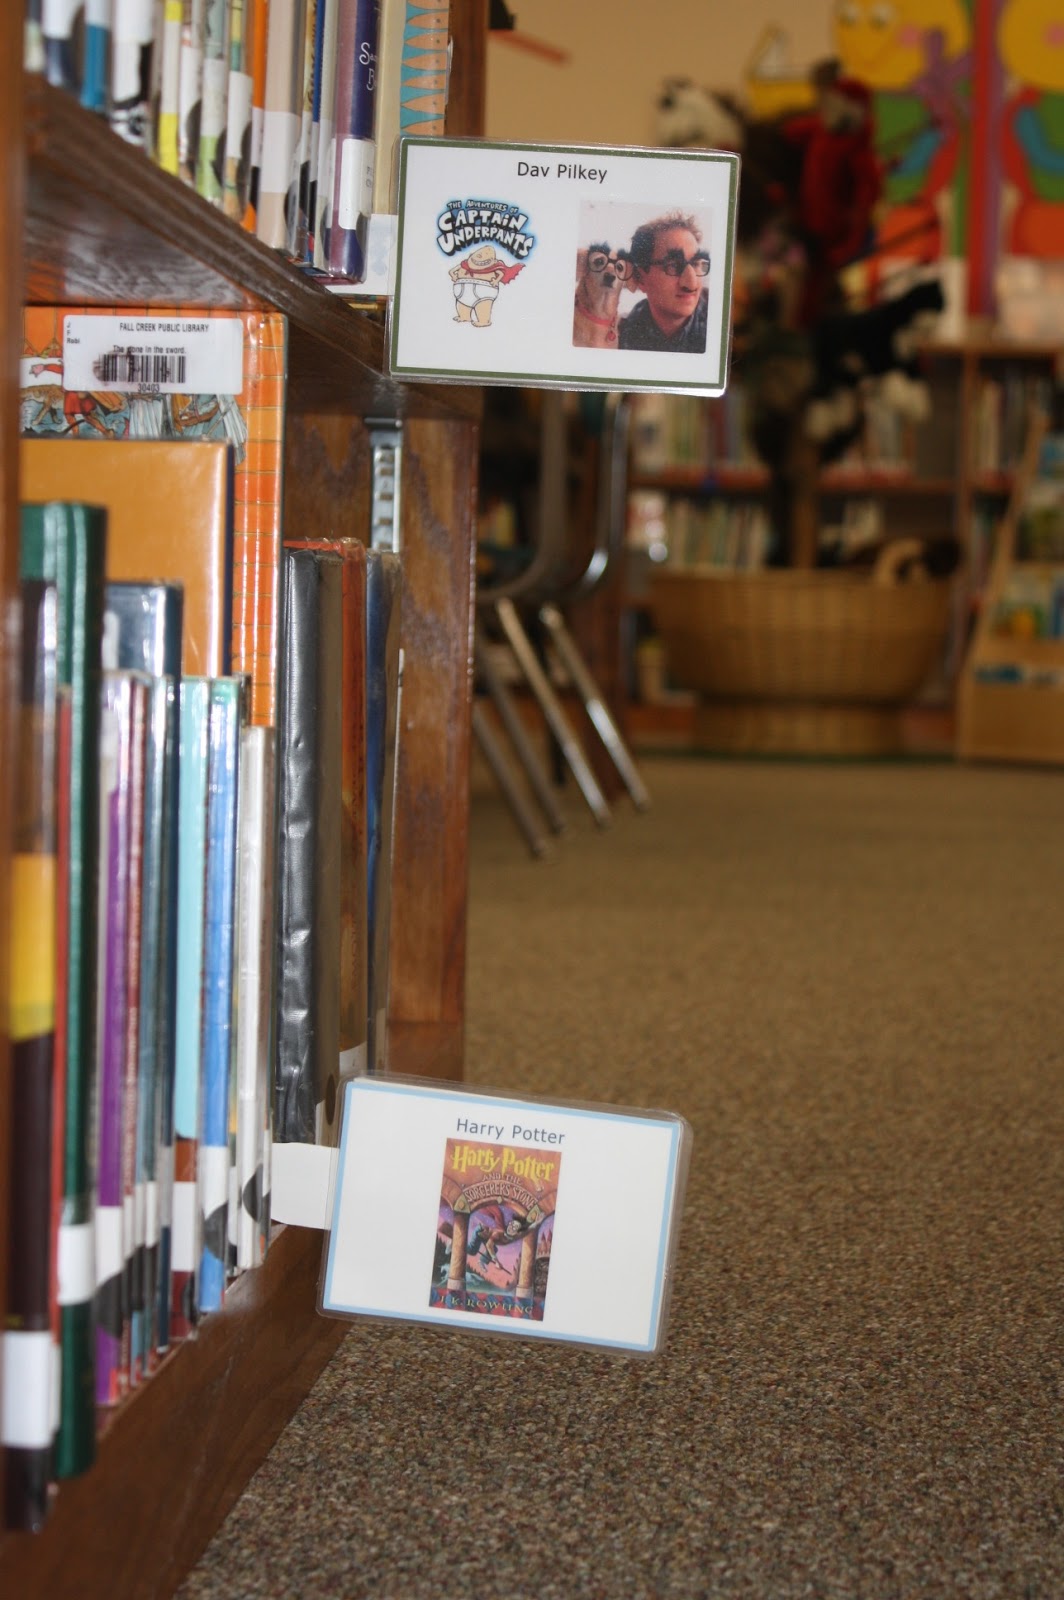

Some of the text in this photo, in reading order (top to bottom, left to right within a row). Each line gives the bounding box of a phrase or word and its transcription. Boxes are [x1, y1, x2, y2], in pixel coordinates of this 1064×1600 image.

[517, 161, 608, 184] Dav Pilkey
[447, 199, 519, 215] THE ADVENTURES OF
[436, 225, 535, 258] UNDERPANTS
[119, 322, 210, 333] FALL CREEK PUBLIC LIBRARY
[113, 345, 125, 354] The
[145, 346, 152, 354] in
[154, 346, 164, 354] the
[166, 346, 187, 354] sword.
[138, 383, 160, 393] 30403
[456, 1118, 565, 1144] Harry Potter
[451, 1144, 555, 1181] Harry Potter
[482, 1172, 522, 1186] AND THE
[512, 1185, 537, 1211] STONE
[466, 1298, 534, 1315] ROWLING
